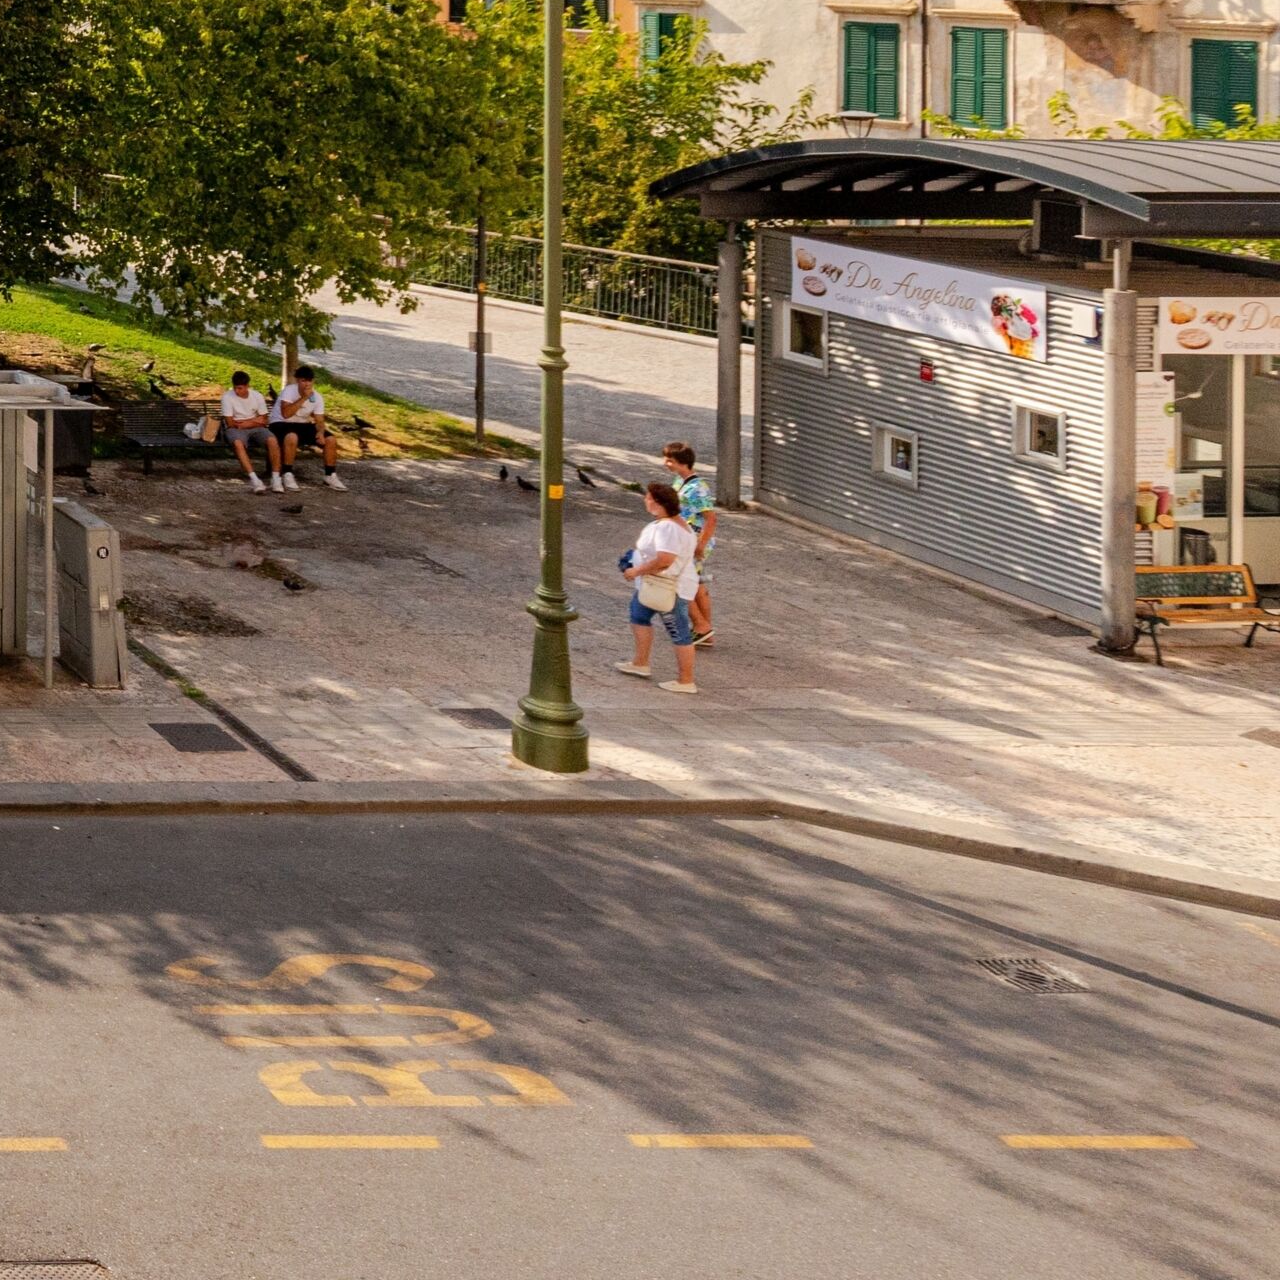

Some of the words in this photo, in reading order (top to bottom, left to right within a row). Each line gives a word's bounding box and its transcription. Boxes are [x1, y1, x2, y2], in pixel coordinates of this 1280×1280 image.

[845, 260, 882, 290] Da
[886, 272, 977, 312] Angelina
[164, 952, 575, 1107] BUS
